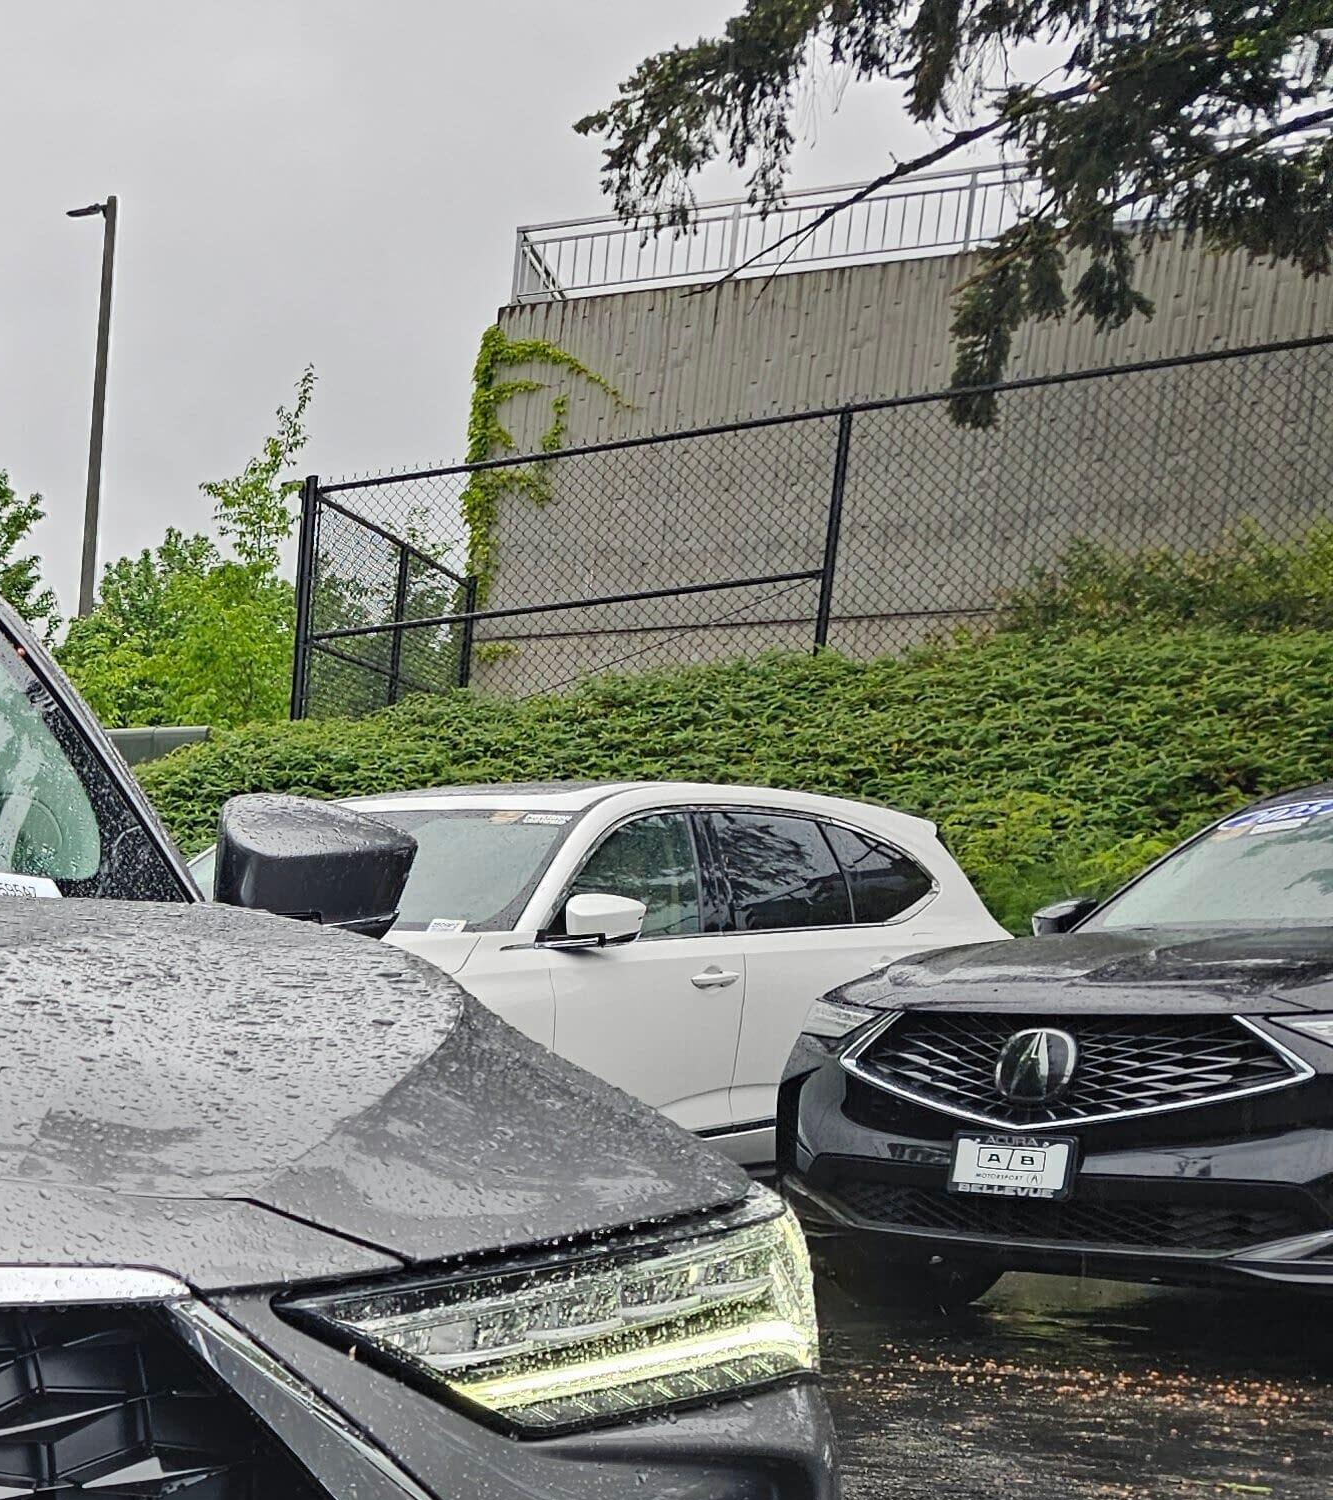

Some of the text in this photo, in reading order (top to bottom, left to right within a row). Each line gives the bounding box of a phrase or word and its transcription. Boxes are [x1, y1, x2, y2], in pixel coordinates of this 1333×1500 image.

[985, 1135, 1038, 1147] ACURA
[987, 1153, 1034, 1165] A B
[975, 1173, 1023, 1181] MOTORSPORT
[957, 1183, 1054, 1198] BELLEVUE
